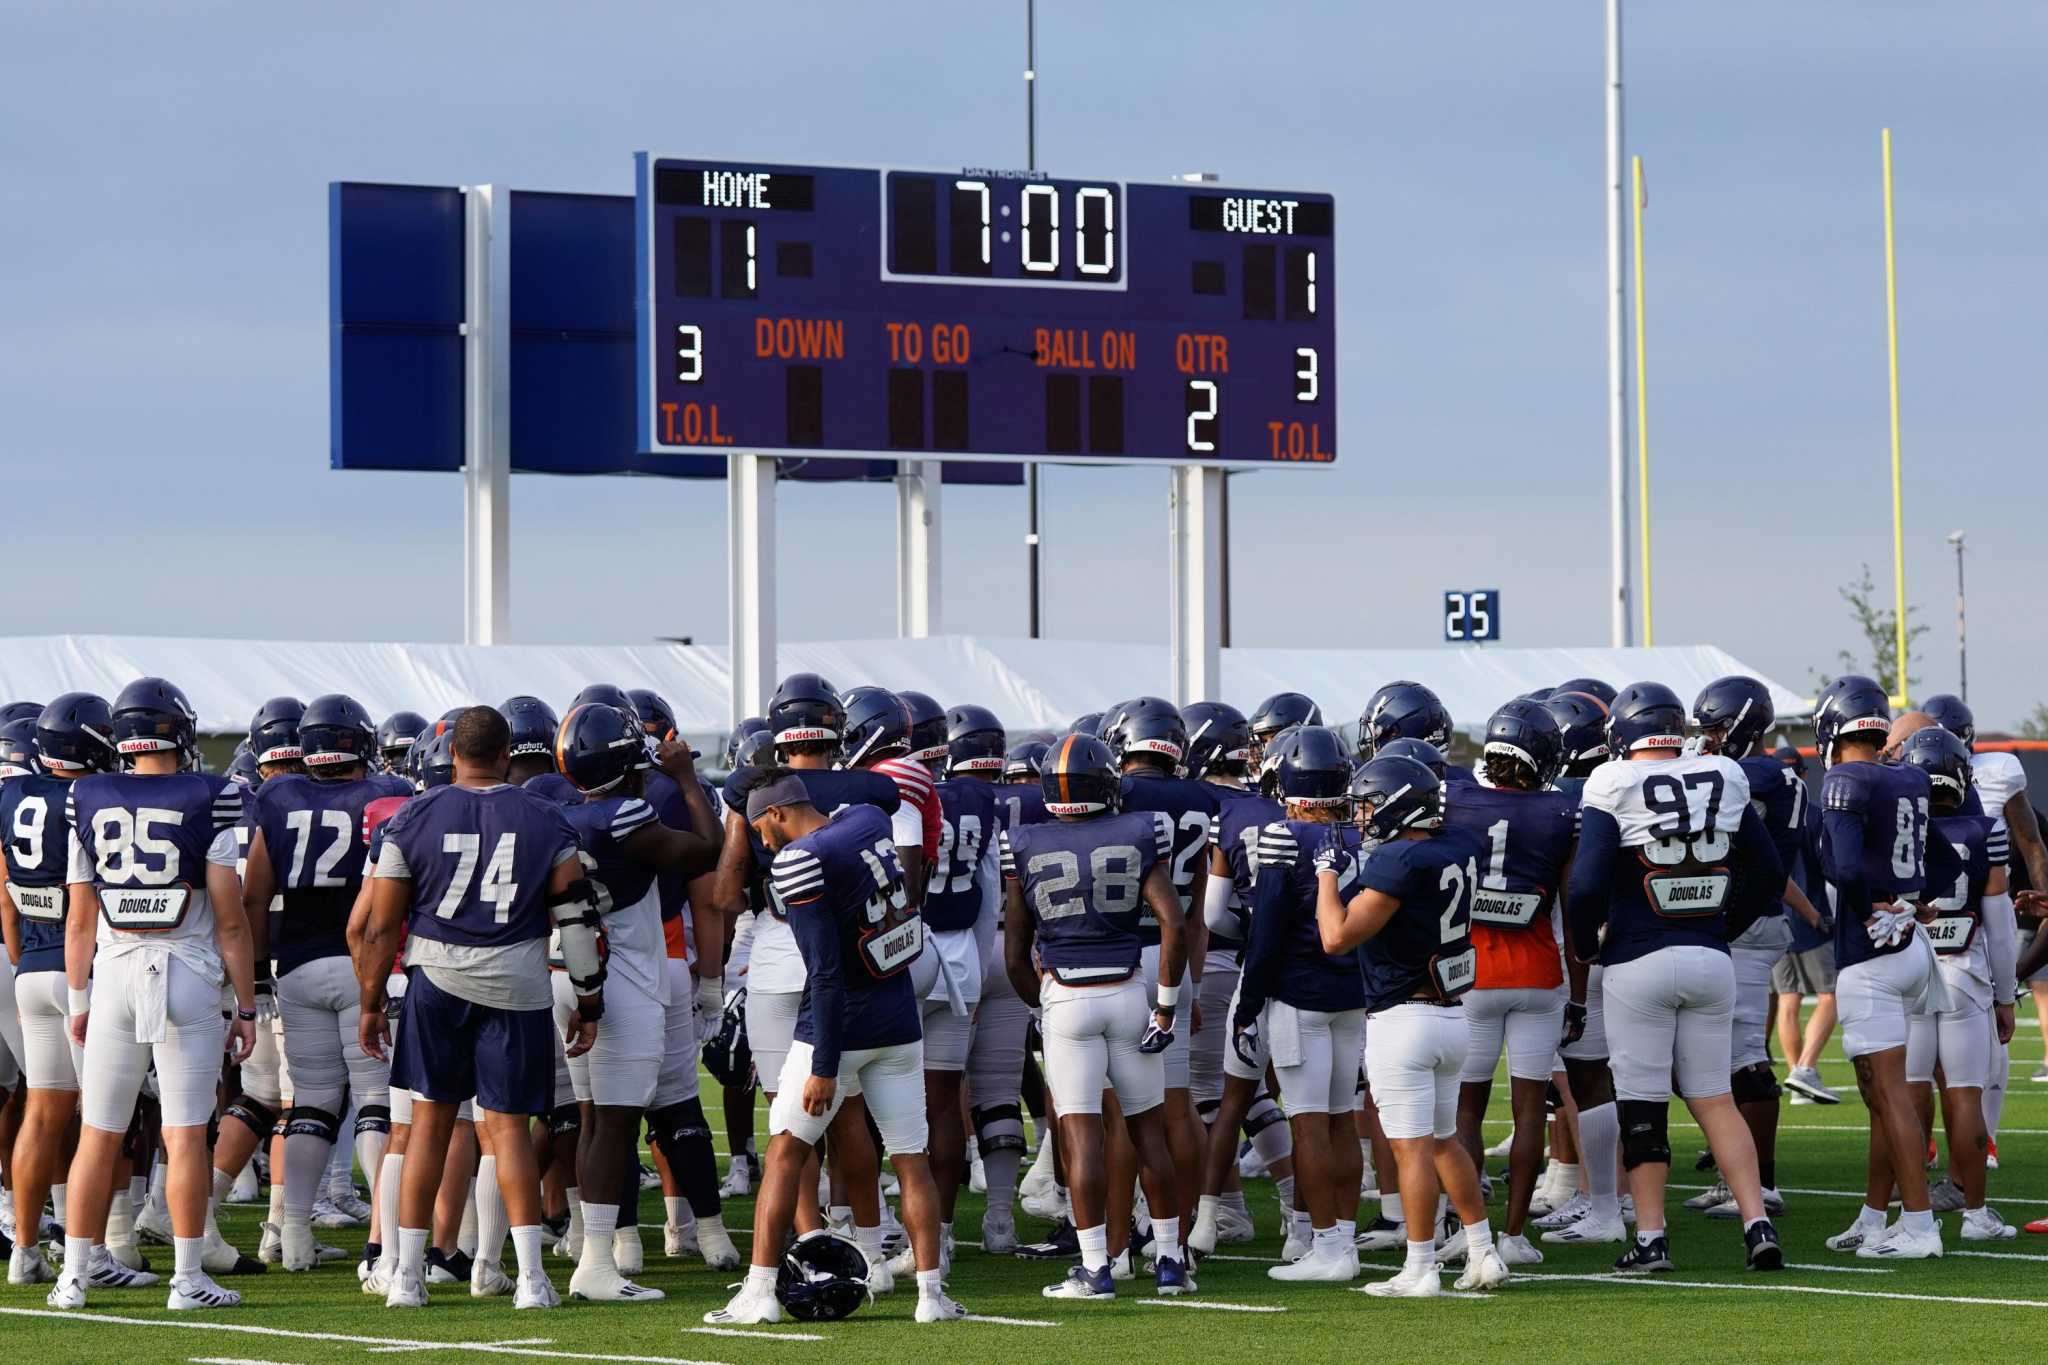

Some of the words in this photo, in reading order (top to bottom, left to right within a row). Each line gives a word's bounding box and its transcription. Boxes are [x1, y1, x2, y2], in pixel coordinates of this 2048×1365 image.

[703, 170, 771, 209] HOME
[955, 181, 1113, 274] 7:00
[1222, 197, 1299, 235] GUEST
[746, 226, 756, 291] 1
[1307, 252, 1317, 314] 1
[678, 325, 702, 381] 3
[755, 318, 844, 359] DOWN
[886, 322, 924, 363] TO
[931, 324, 970, 364] GO
[1034, 328, 1096, 368] BALL
[1101, 331, 1136, 369] ON
[1175, 334, 1229, 374] QTR
[1296, 347, 1318, 401] 3
[662, 402, 734, 445] T.O.L.
[1187, 380, 1218, 451] 2
[1266, 421, 1334, 462] T.O.L.
[1447, 592, 1490, 638] 25
[121, 740, 158, 752] Riddell
[517, 741, 544, 751] schutt
[784, 730, 824, 741] Riddell
[307, 754, 341, 765] Riddell
[1051, 804, 1089, 815] Riddell
[1643, 769, 1725, 841] 97
[10, 795, 48, 870] 9
[91, 806, 184, 885] 85
[286, 809, 353, 889] 72
[1483, 818, 1510, 891] 1
[435, 832, 519, 924] 74
[1027, 845, 1142, 921] 28
[1668, 884, 1713, 902] DOUGLAS
[20, 892, 53, 910] DOUGLAS
[118, 898, 168, 914] DOUGLAS
[1439, 855, 1478, 945] 21
[1473, 898, 1522, 916] DOUGLAS
[884, 929, 915, 960] DOUGLAS
[1448, 959, 1470, 982] DOUGLAS
